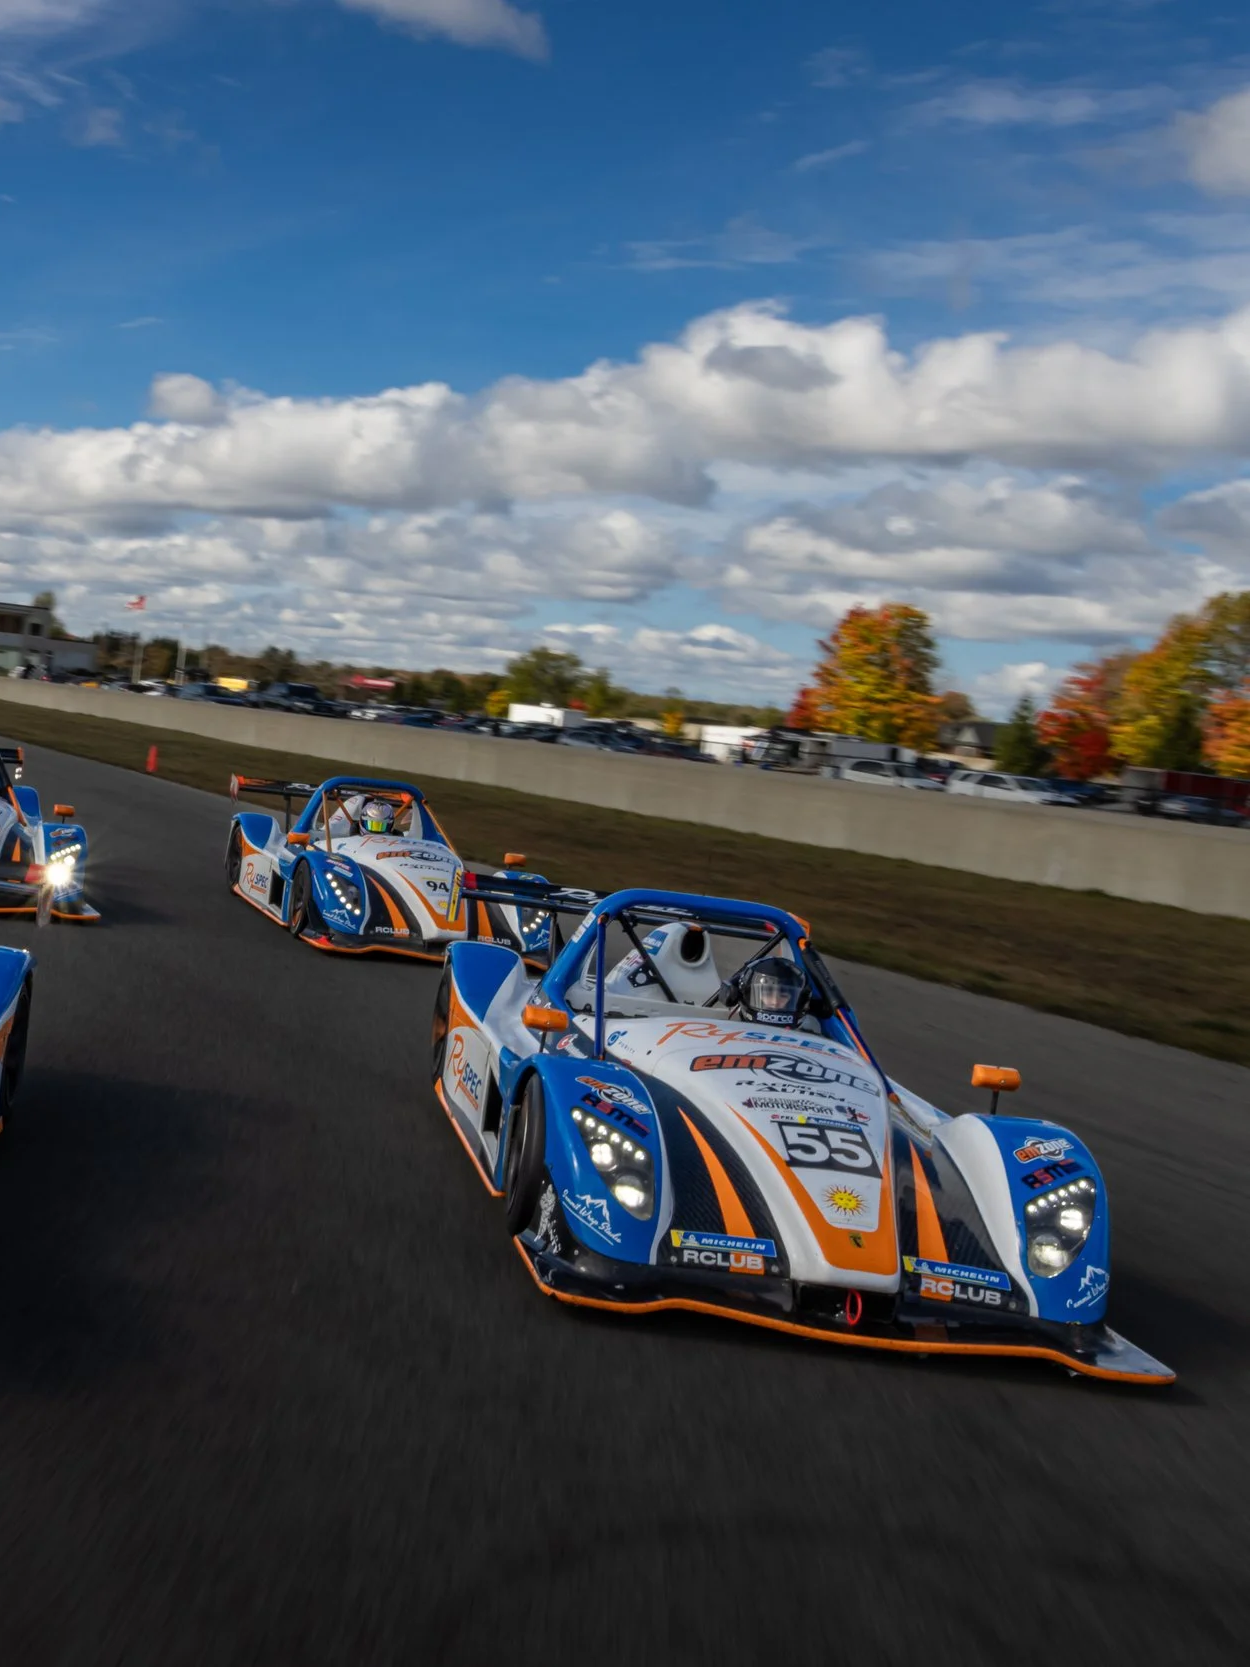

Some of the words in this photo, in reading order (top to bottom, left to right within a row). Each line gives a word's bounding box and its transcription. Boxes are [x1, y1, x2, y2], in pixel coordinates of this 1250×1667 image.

[426, 880, 450, 893] 94
[375, 926, 411, 936] RCLUB
[756, 1012, 794, 1025] sparco
[688, 1053, 882, 1097] emzone
[751, 1101, 834, 1115] MOTORSPORT
[781, 1125, 874, 1169] 55
[1013, 1137, 1075, 1164] emzone
[700, 1237, 766, 1251] MICHELIN
[682, 1249, 763, 1270] RCLUB
[933, 1265, 1000, 1284] MICHELIN
[920, 1278, 1003, 1306] RCLUB
